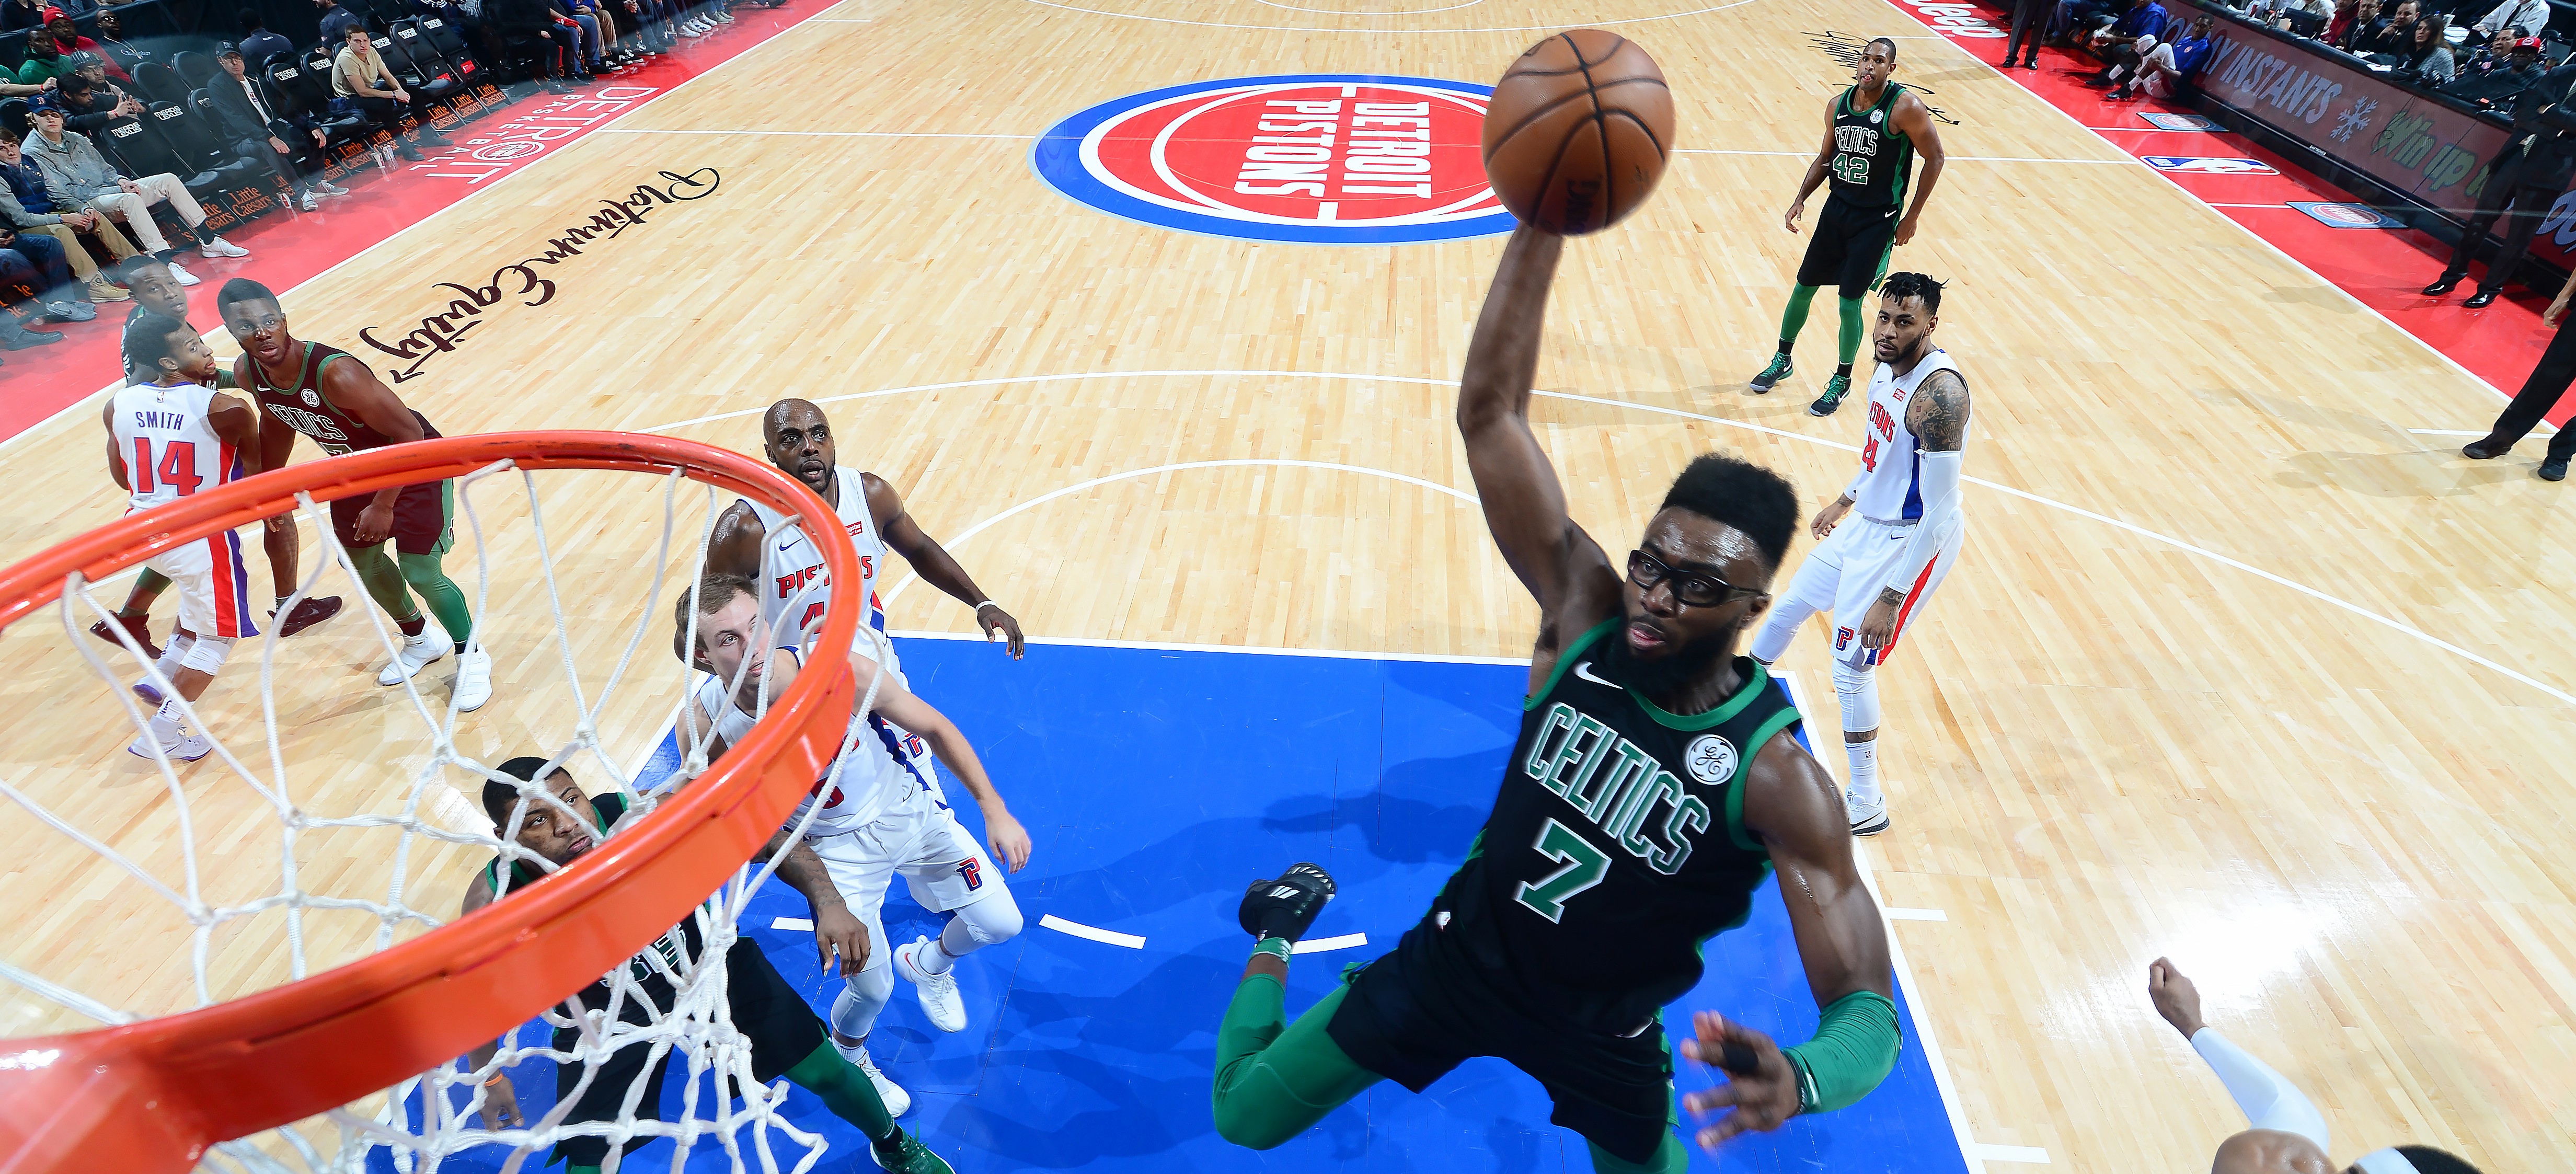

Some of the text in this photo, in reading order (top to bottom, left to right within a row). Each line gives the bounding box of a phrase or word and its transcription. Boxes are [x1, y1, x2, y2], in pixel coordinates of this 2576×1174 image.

[476, 84, 497, 97] Little
[2220, 45, 2342, 123] INSTANTS
[452, 94, 474, 108] Little
[480, 91, 505, 107] Caesars
[154, 106, 181, 118] MEADE
[159, 110, 183, 121] LEXUS
[427, 106, 450, 119] Little
[455, 101, 483, 118] Caesars
[111, 122, 140, 136] MEADE
[430, 113, 459, 130] Caesars
[117, 127, 143, 138] LEXUS
[409, 95, 586, 171] BASKETBALL
[1834, 125, 1878, 156] CELTICS
[338, 142, 365, 158] Little
[1234, 100, 1342, 198] PISTONS
[1341, 101, 1433, 199] DETROIT
[2370, 110, 2435, 170] Win
[2422, 143, 2477, 192] up
[341, 151, 372, 169] Caesar
[1833, 153, 1869, 185] 42
[228, 186, 261, 205] Little
[232, 195, 273, 217] Caesars
[204, 212, 235, 231] esars
[359, 168, 720, 383] Platinum Equity
[135, 411, 184, 430] SMITH
[134, 437, 203, 496] 14
[1522, 701, 1711, 876] CELTICS
[1512, 816, 1613, 925] 7
